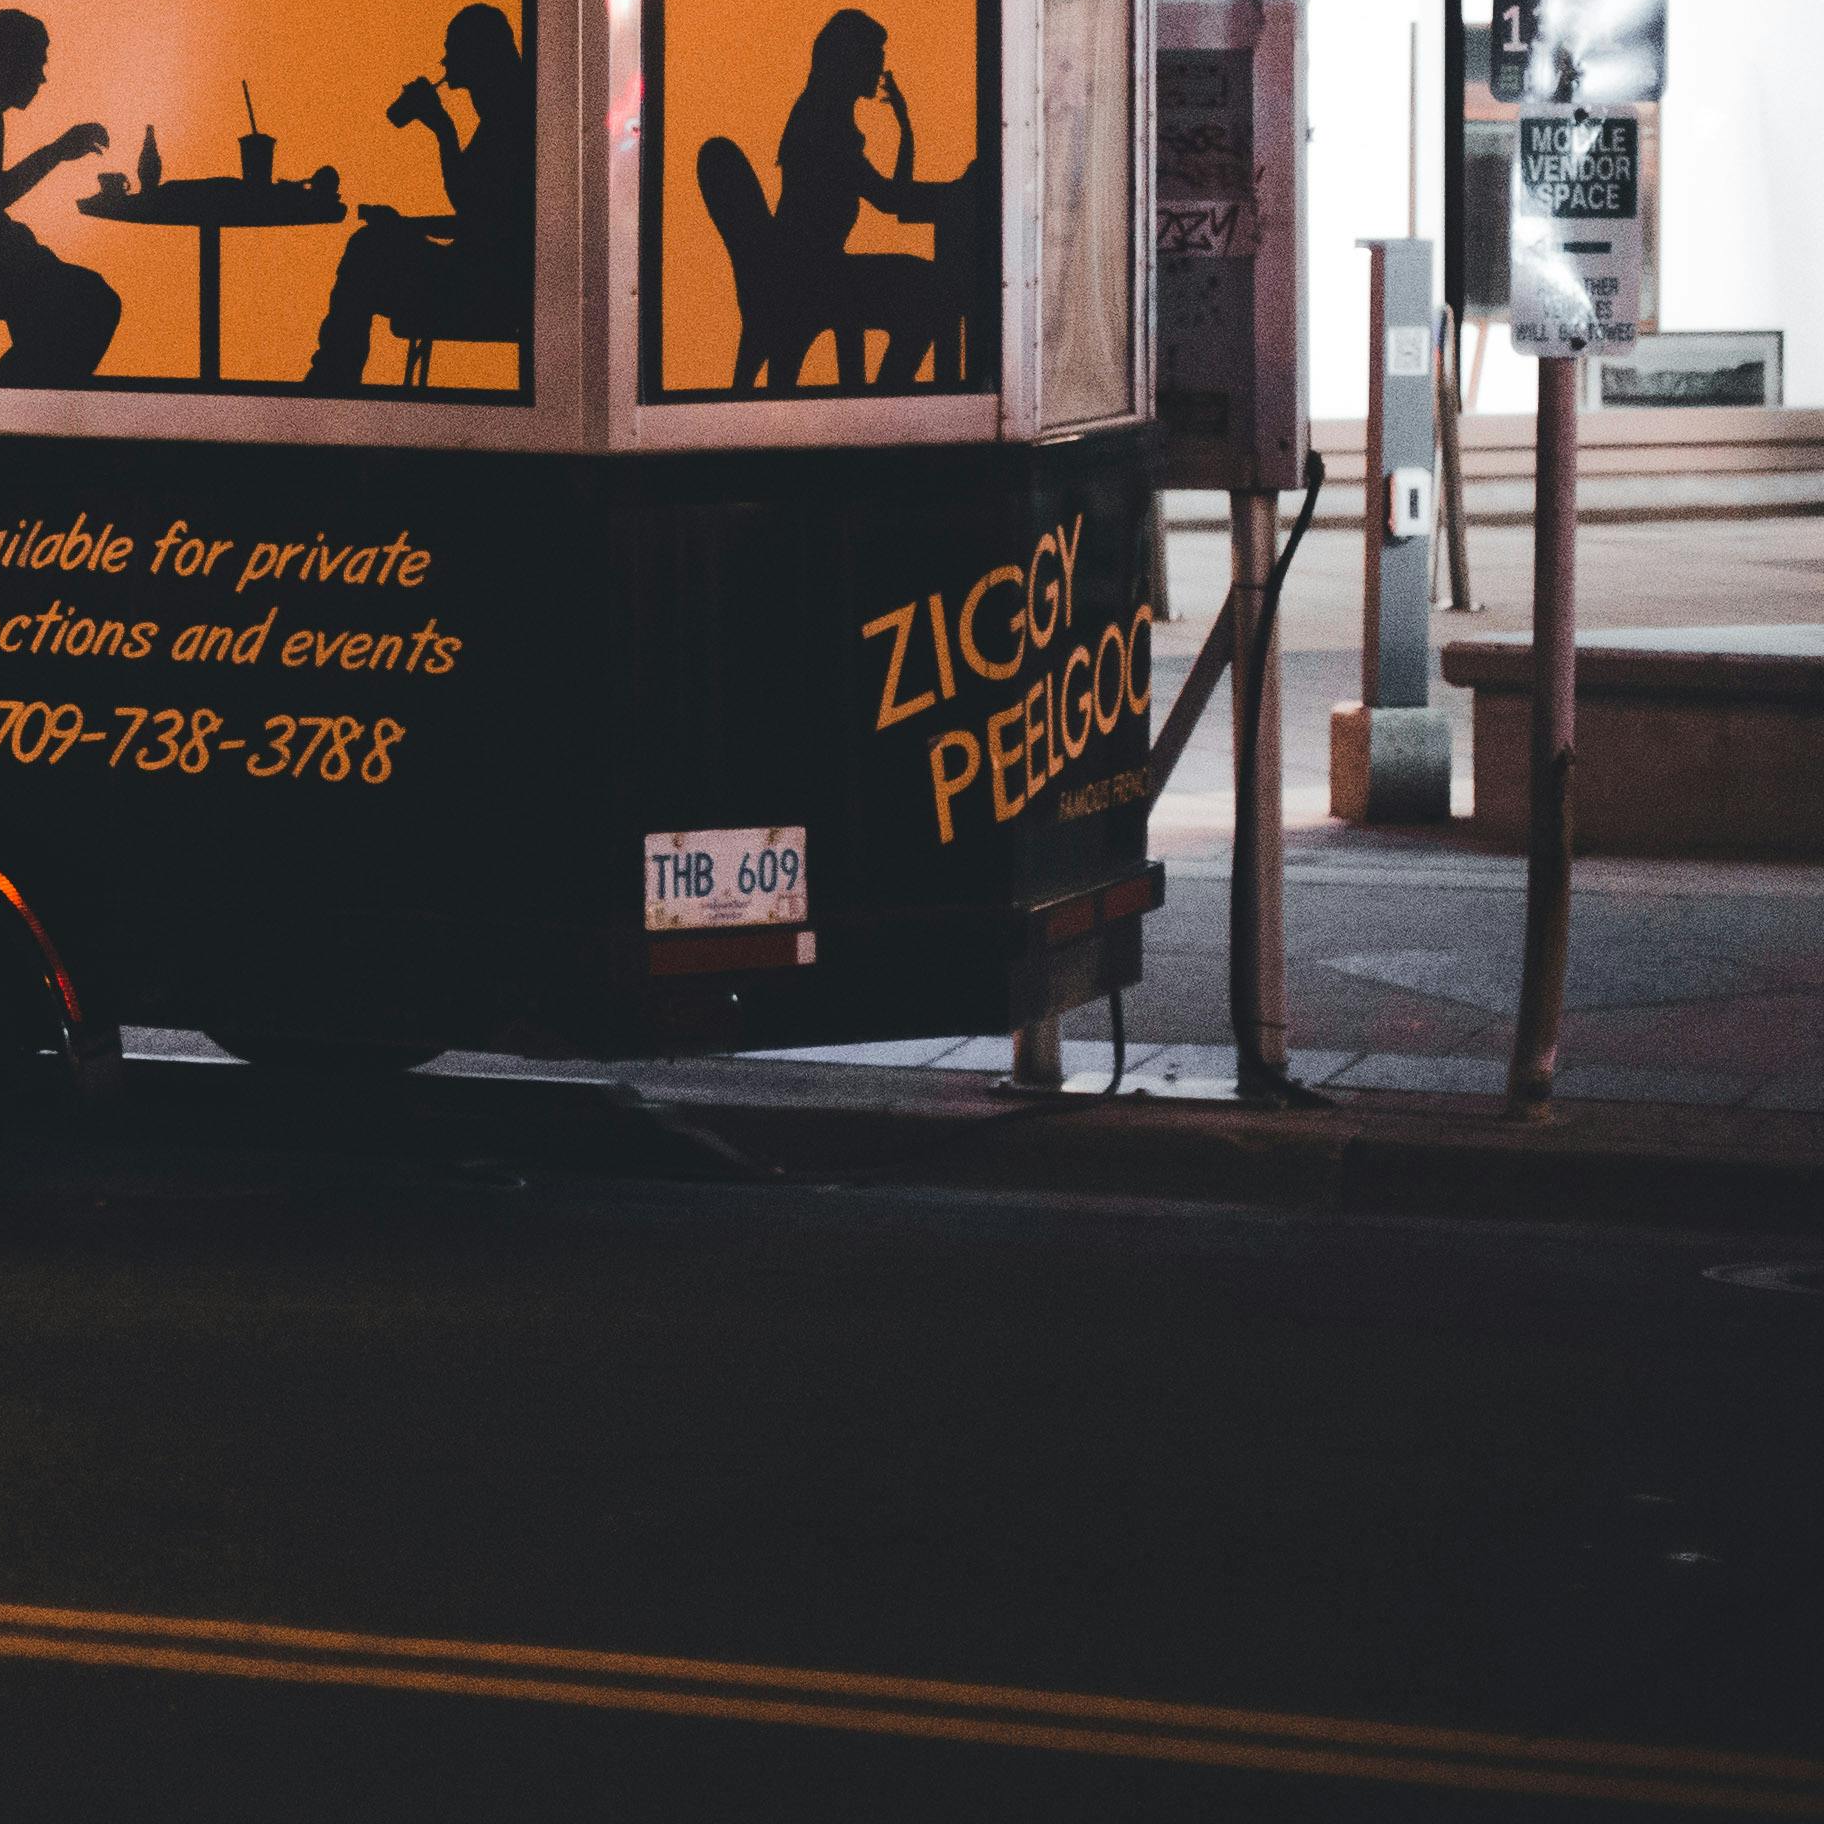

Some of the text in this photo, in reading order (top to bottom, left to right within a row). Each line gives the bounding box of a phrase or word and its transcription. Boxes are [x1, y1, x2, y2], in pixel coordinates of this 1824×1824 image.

[1527, 155, 1631, 181] VENDOR
[1536, 183, 1621, 210] SPACE
[149, 519, 234, 578] for
[234, 529, 432, 594] private
[170, 606, 279, 665] and
[280, 618, 464, 675] events
[861, 512, 1084, 732] ZIGGY
[653, 848, 800, 900] THB 609
